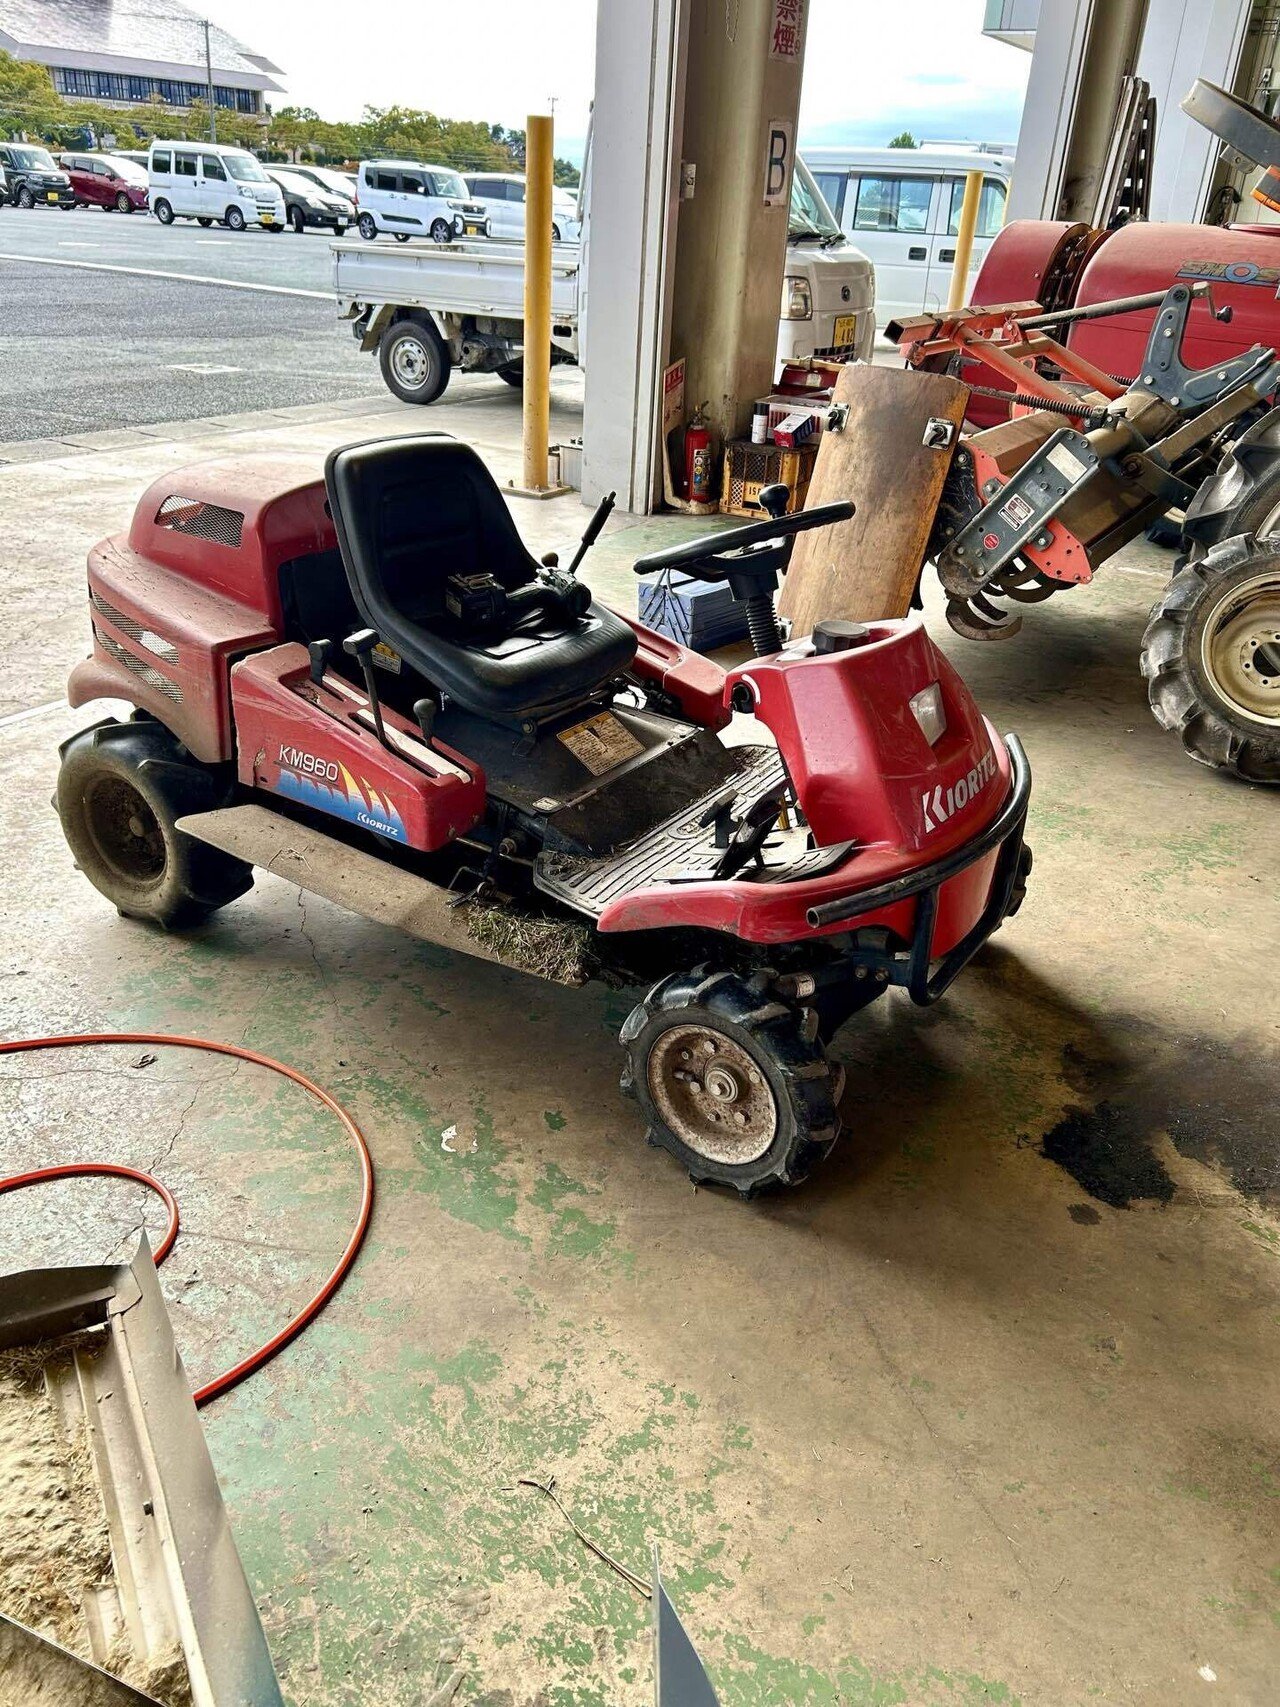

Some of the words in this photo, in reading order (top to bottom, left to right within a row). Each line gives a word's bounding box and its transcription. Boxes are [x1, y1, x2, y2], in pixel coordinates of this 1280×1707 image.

[766, 130, 787, 195] B
[279, 744, 340, 781] KM960
[922, 748, 997, 834] KIORITZ
[356, 811, 399, 836] KIORITZ
